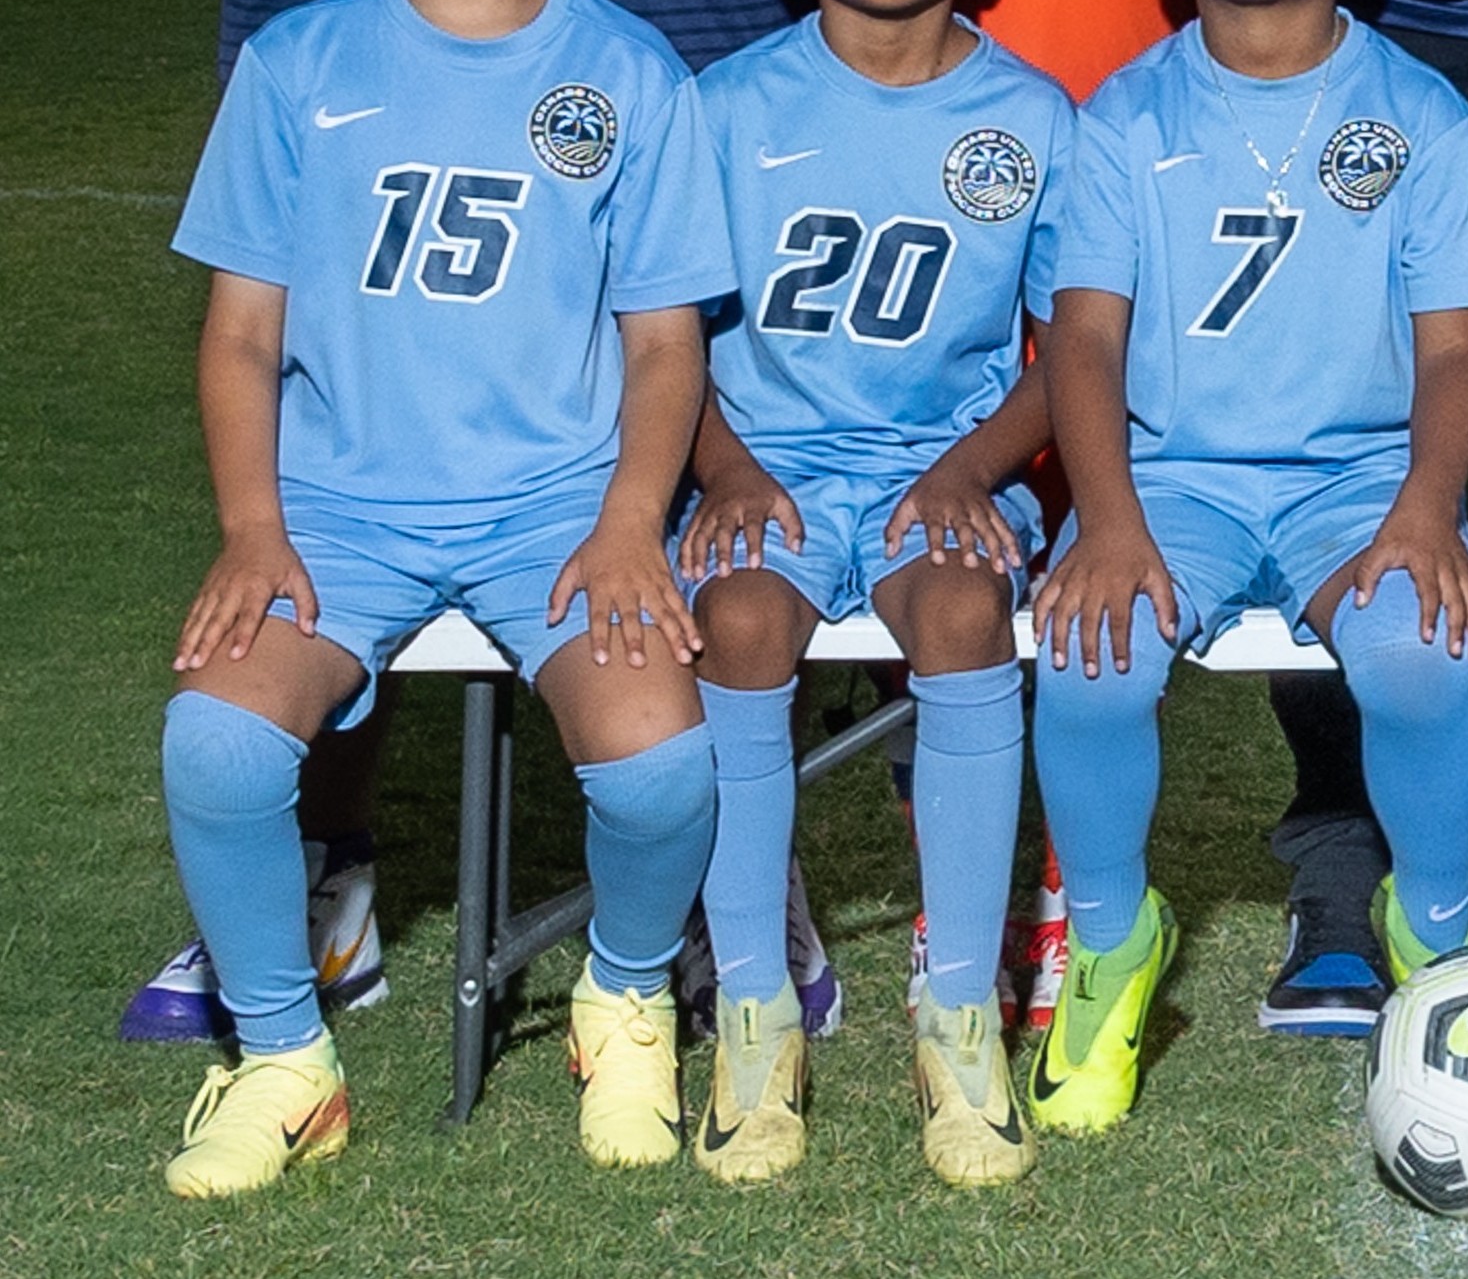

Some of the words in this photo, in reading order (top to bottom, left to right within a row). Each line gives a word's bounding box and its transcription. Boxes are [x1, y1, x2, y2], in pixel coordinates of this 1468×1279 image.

[534, 135, 581, 175] SOCCER
[1000, 135, 1035, 179] UNITED
[359, 162, 533, 304] 15
[947, 184, 994, 221] SOCCER
[996, 192, 1030, 219] CLUB
[757, 207, 957, 348] 20
[1185, 208, 1305, 338] 7
